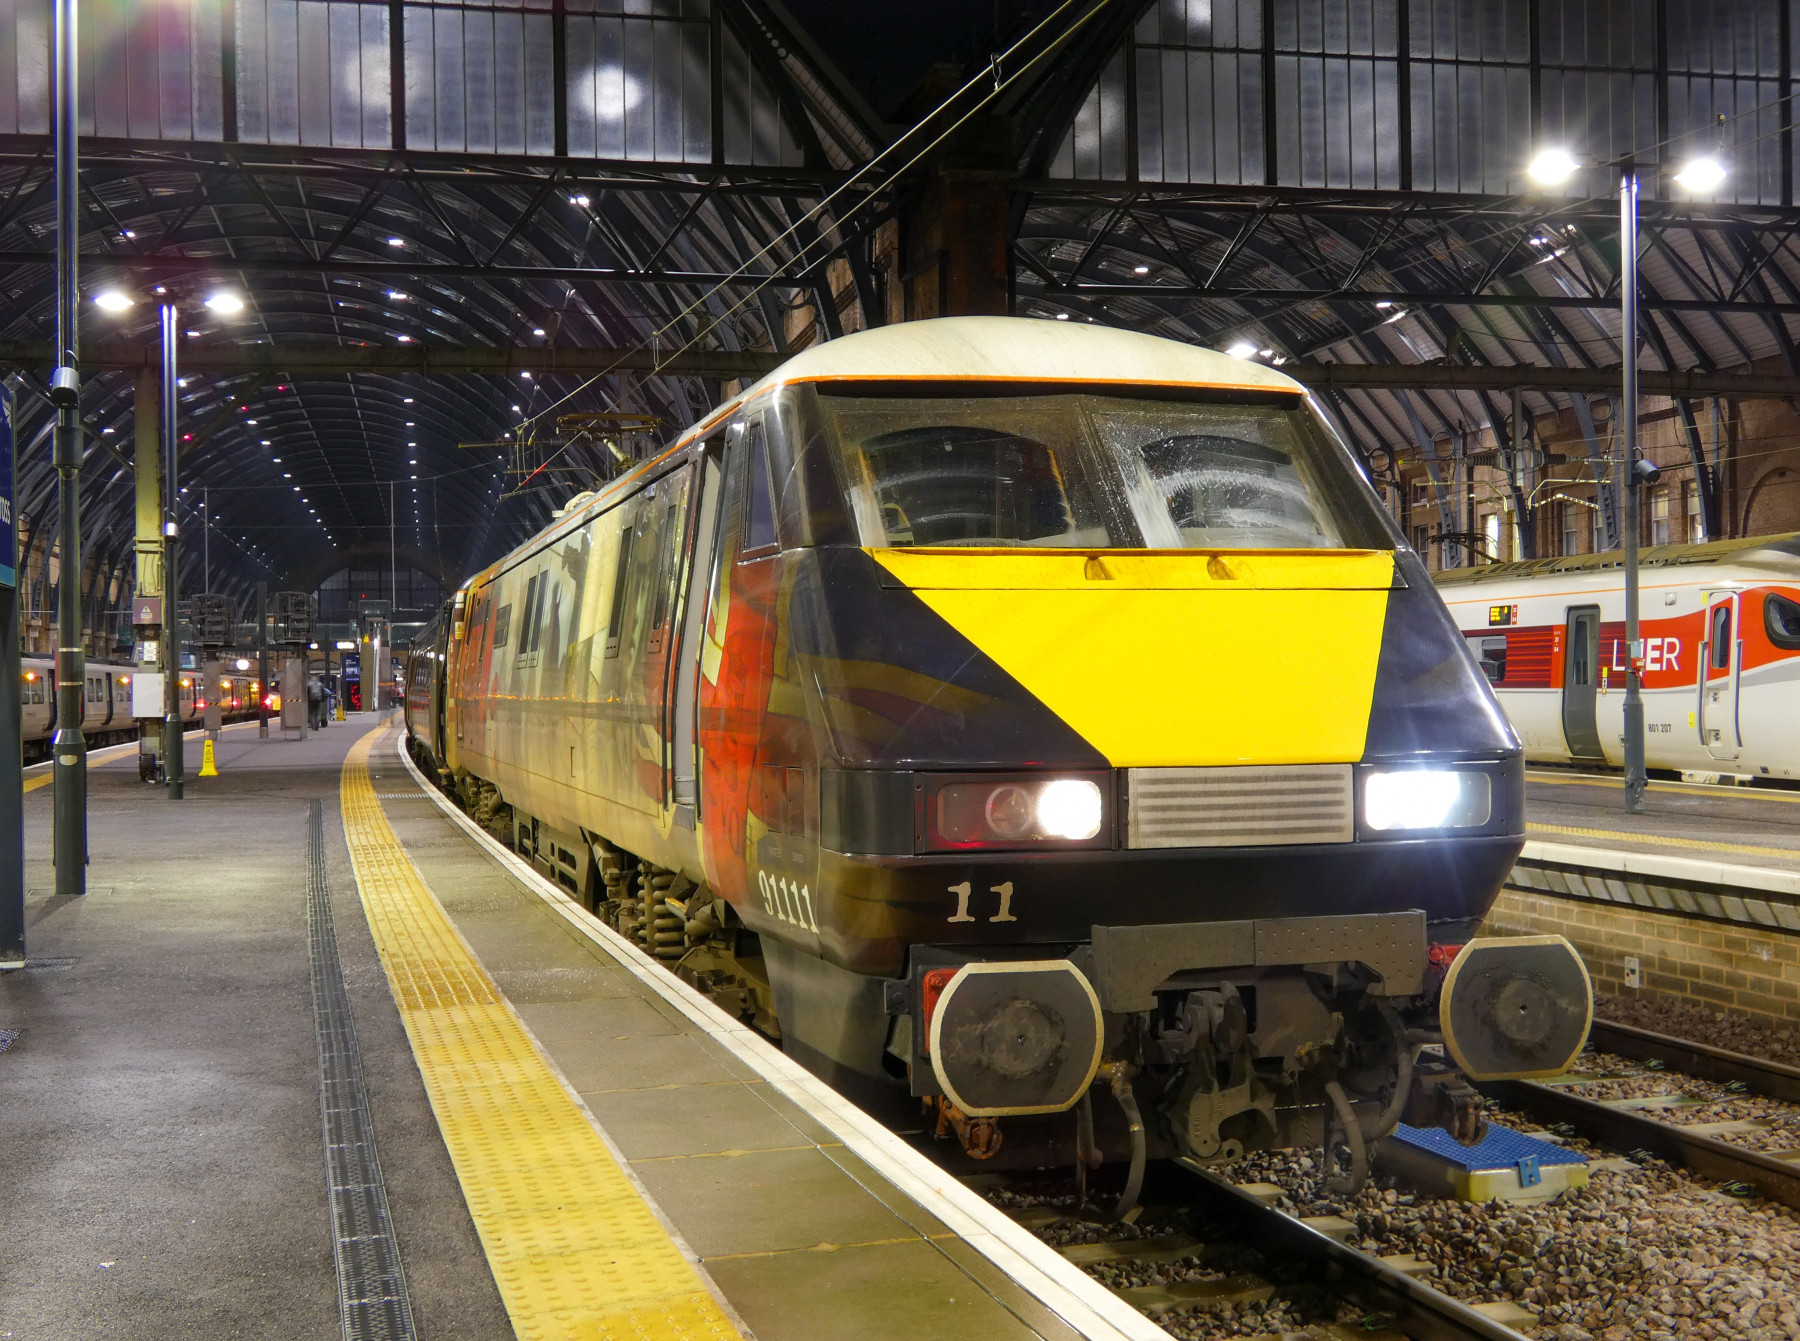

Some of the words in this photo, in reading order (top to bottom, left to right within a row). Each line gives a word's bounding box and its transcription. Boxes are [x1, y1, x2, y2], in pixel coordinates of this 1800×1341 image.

[1612, 637, 1680, 675] LER
[759, 869, 820, 934] 91111
[947, 881, 1018, 923] 11
